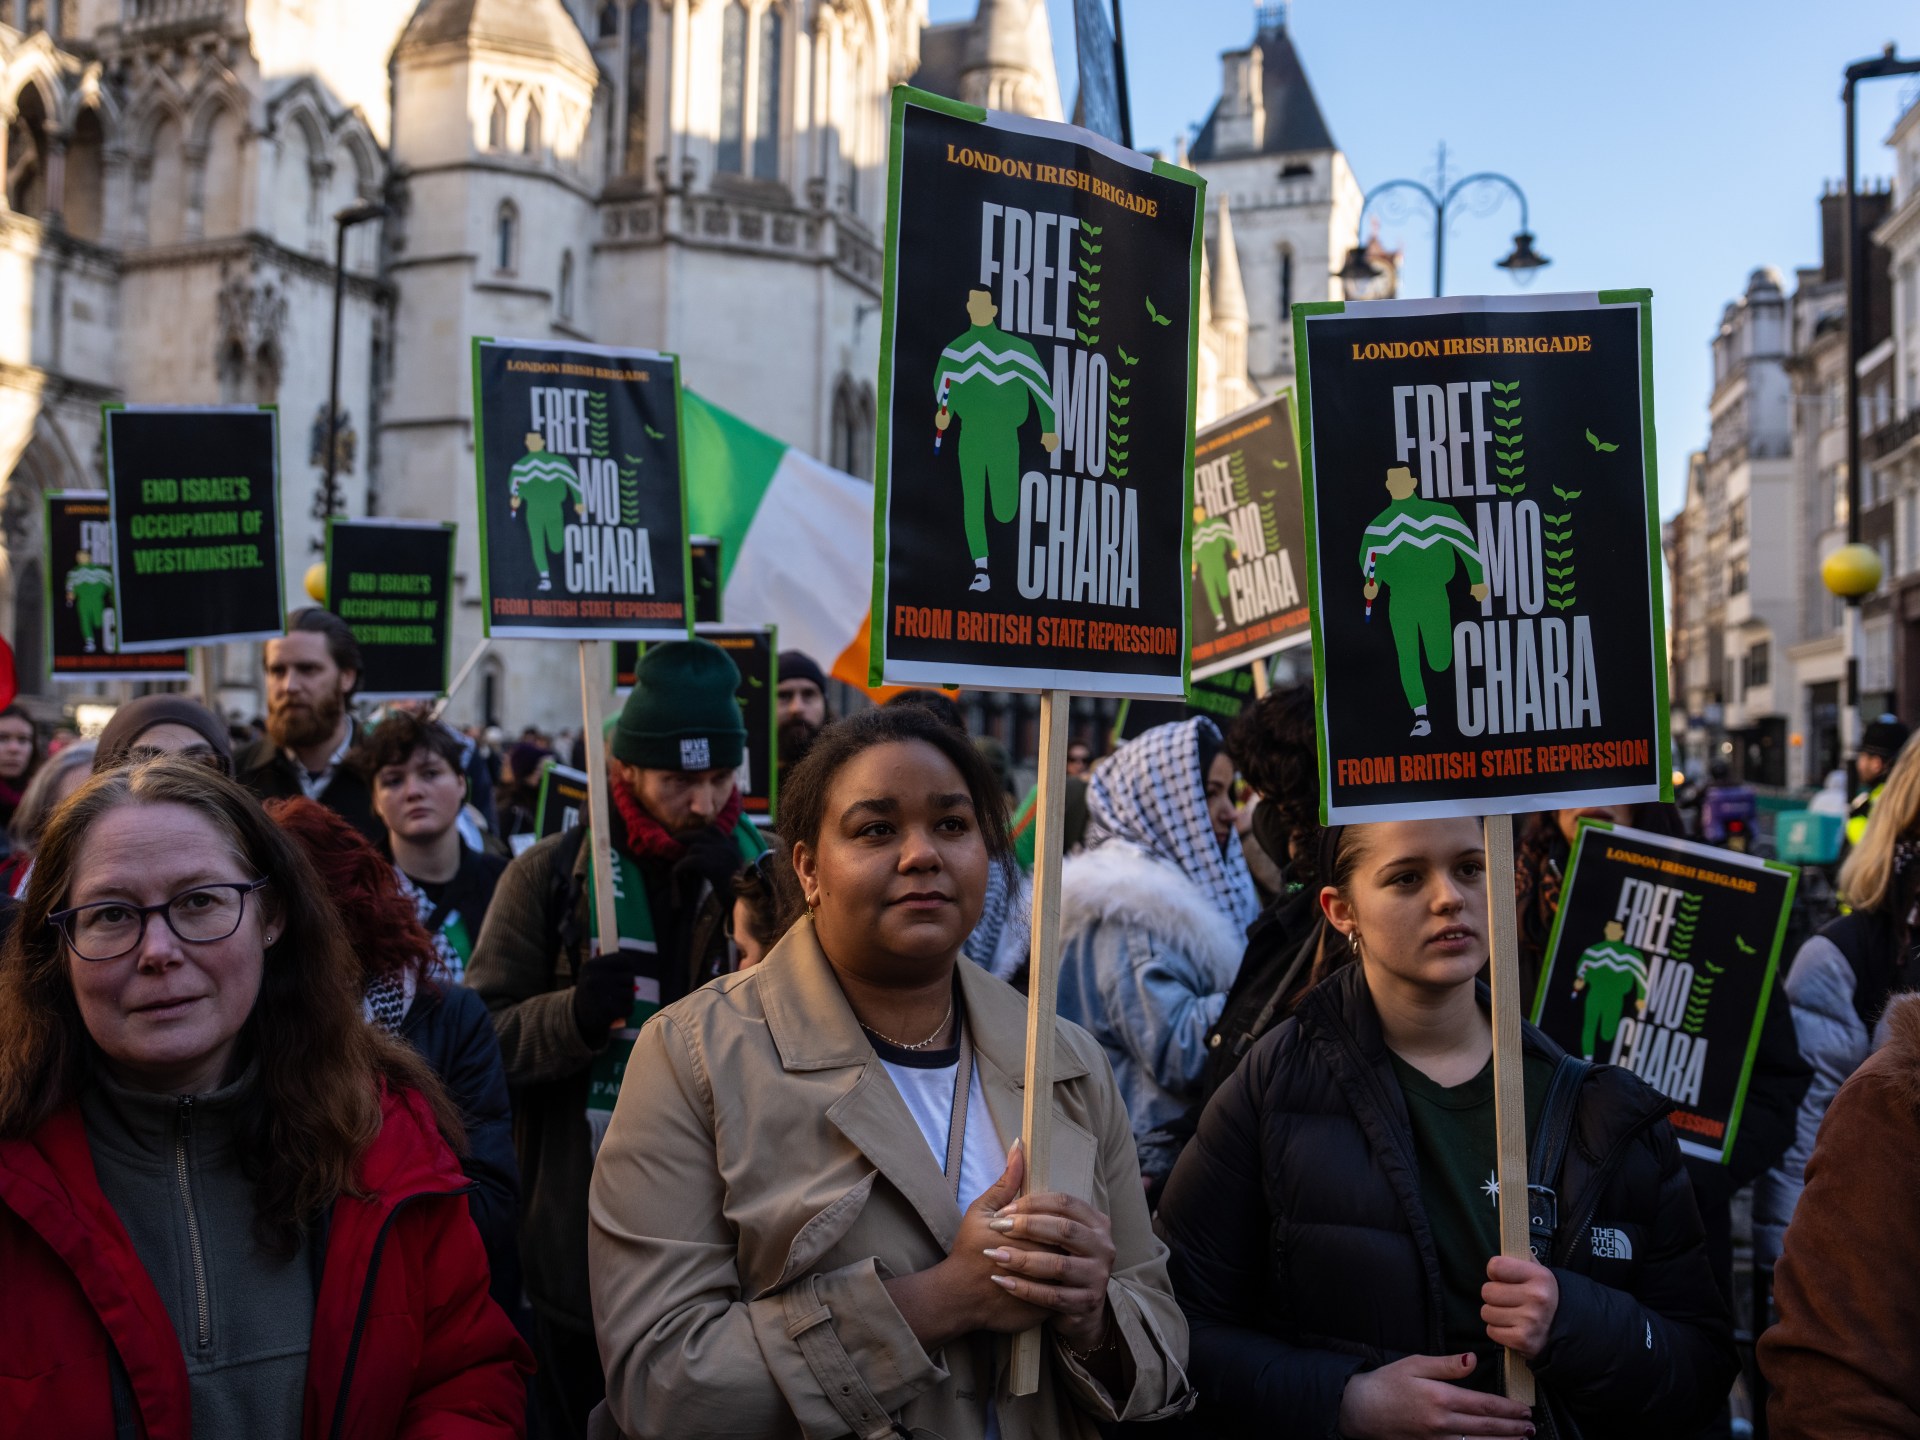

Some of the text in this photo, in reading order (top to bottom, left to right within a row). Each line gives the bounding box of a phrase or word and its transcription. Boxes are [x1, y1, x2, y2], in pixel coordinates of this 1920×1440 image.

[947, 144, 1157, 218] LONDON IRISH BRIGADE
[980, 202, 1080, 341] FREE
[507, 360, 649, 382] LONDON IRISH BRIGADE
[1352, 335, 1591, 360] LONDON IRISH BRIGADE
[530, 386, 592, 455] FREE
[1050, 345, 1108, 478] MO
[1393, 381, 1496, 498] FREE
[142, 477, 250, 504] END ISRAEL'S
[578, 458, 620, 525] MO
[1195, 454, 1239, 518] FREE
[130, 511, 262, 539] OCCUPATION OF
[1016, 472, 1140, 608] CHARA
[1230, 502, 1266, 564] MO
[134, 545, 263, 574] WESTMINSTER.
[349, 573, 376, 593] END
[564, 525, 654, 595] CHARA
[1228, 549, 1300, 626] CHARA
[1476, 500, 1544, 616] MO
[339, 598, 419, 619] OCCUPATION
[494, 598, 682, 619] FROM BRITISH STATE REPRESSION
[895, 605, 1177, 656] FROM BRITISH STATE REPRESSION
[1453, 615, 1601, 737] CHARA
[1338, 739, 1648, 786] FROM BRITISH STATE REPRESSION
[1606, 848, 1756, 894] LONDON IRISH BRIGADE
[1615, 877, 1684, 956] FREE
[1637, 956, 1694, 1030] MO
[1610, 1017, 1708, 1107] CHARA
[1591, 1237, 1614, 1247] RTH
[1592, 1227, 1613, 1238] THE
[1592, 1247, 1614, 1257] ACE
